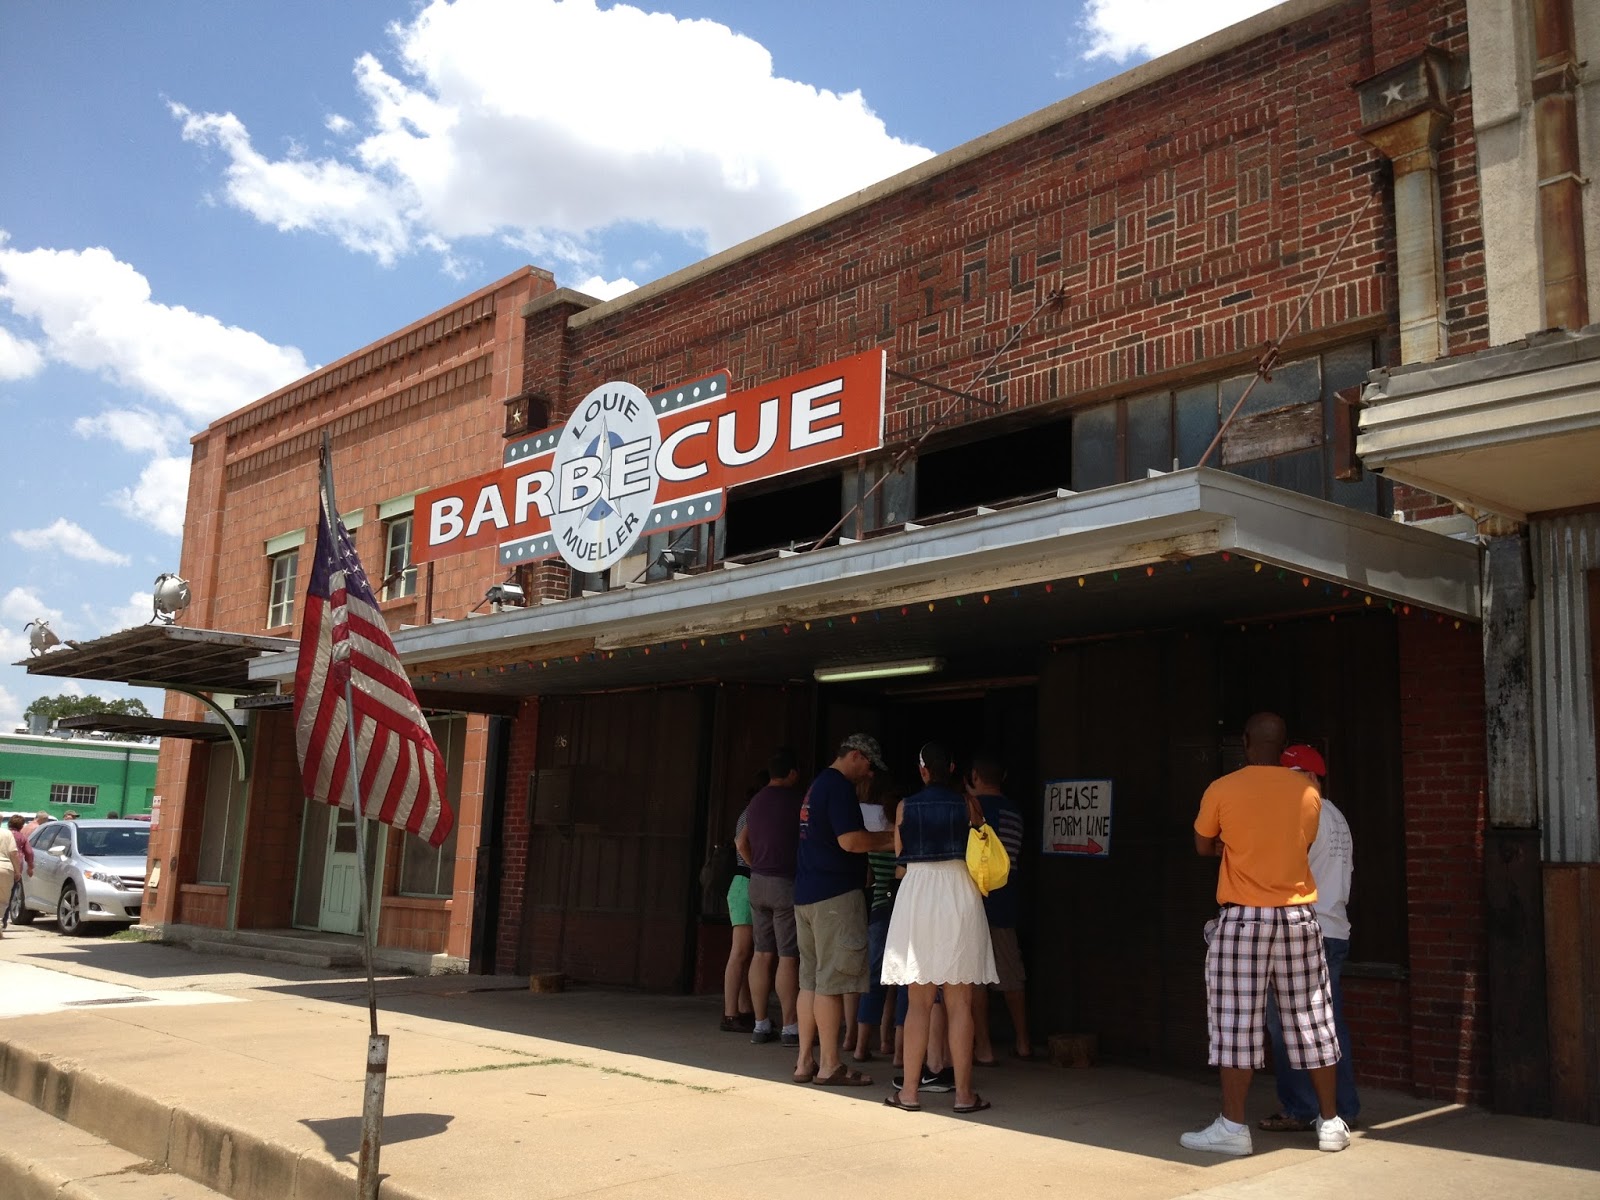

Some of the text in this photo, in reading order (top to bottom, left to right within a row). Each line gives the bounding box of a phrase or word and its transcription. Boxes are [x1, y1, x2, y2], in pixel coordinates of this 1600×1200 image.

[572, 392, 640, 441] LOUIE
[429, 377, 844, 546] BARBECUE
[562, 511, 640, 561] MUELLER
[1049, 785, 1098, 811] PLEASE
[1053, 815, 1109, 837] FORM LINE
